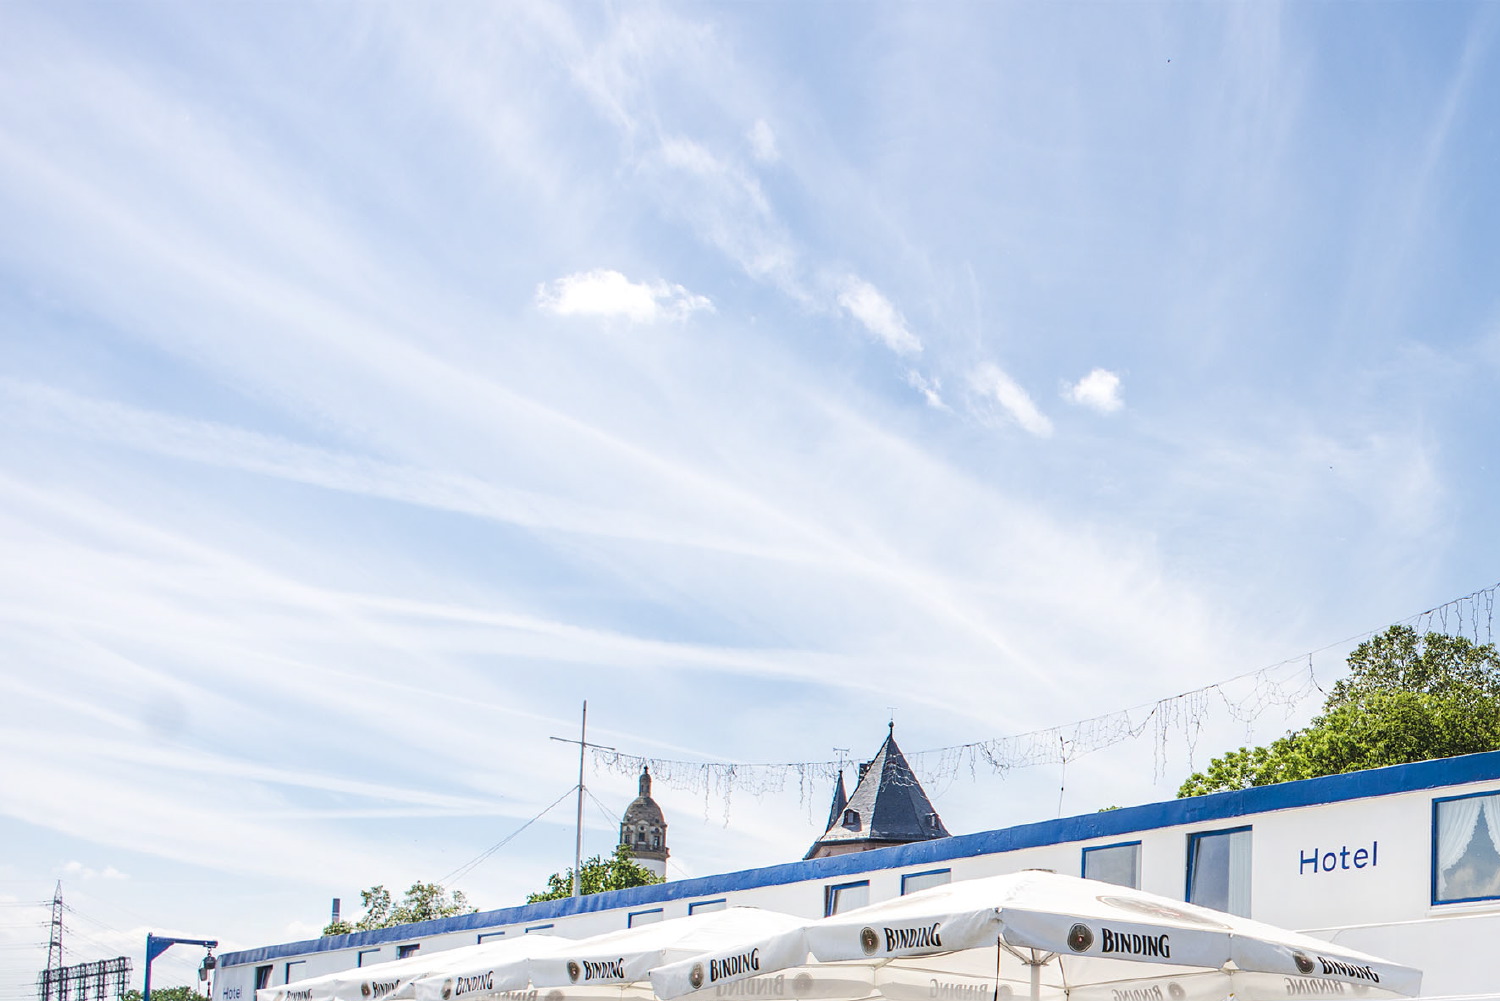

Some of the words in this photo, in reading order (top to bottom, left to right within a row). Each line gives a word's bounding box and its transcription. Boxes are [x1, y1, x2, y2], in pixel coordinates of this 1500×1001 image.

[1299, 841, 1378, 875] Hotel
[883, 922, 942, 952] BINDING
[1101, 928, 1171, 958] BINDING
[582, 957, 625, 981] BINDING
[710, 948, 760, 982] BINDING
[1317, 956, 1380, 983] BINDING
[223, 985, 242, 1000] Hotel
[456, 970, 494, 996] BINDING
